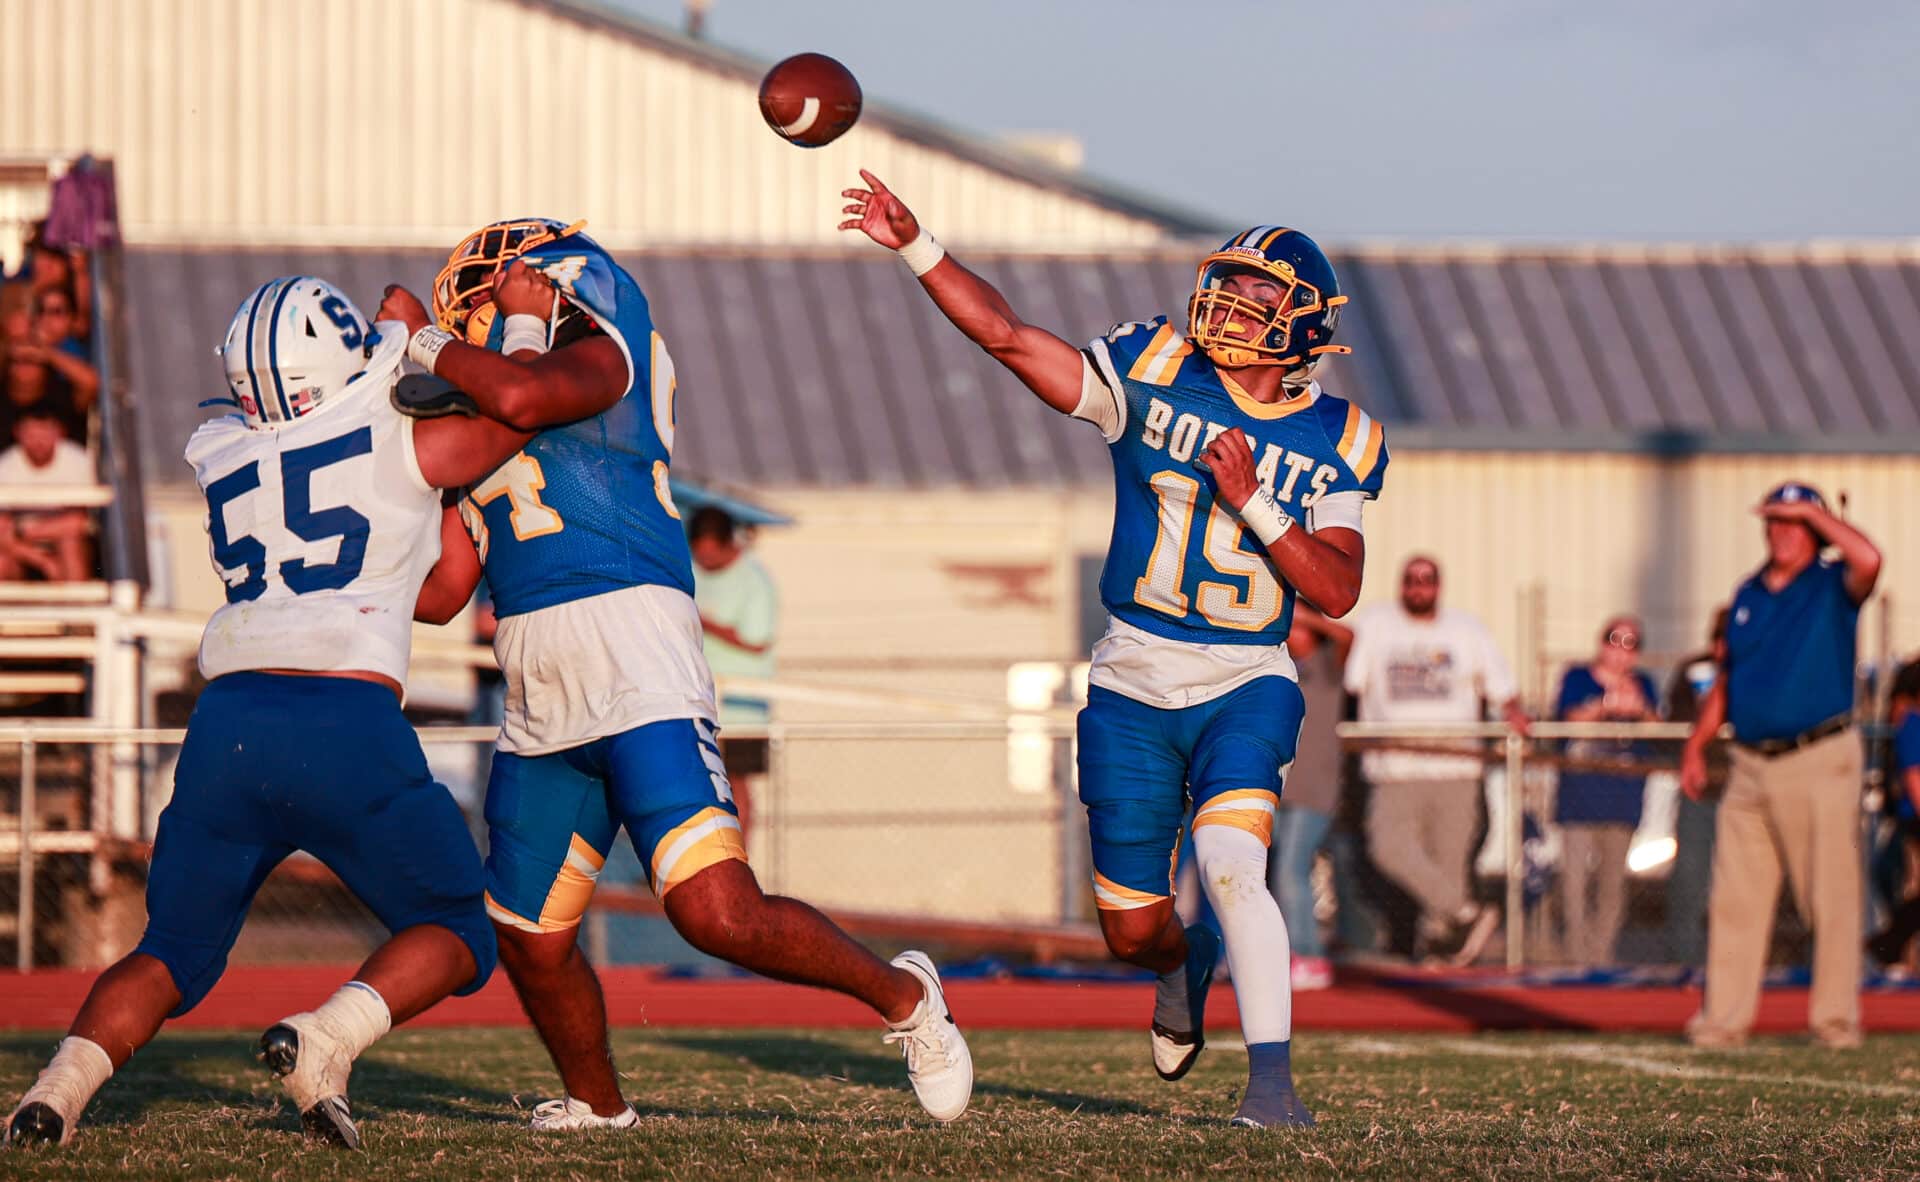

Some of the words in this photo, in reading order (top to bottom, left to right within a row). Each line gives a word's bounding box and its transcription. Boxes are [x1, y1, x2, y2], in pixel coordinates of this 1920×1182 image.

[320, 295, 363, 351] S
[205, 425, 373, 604] 55
[1141, 397, 1339, 508] BOATS
[1134, 470, 1284, 632] 15
